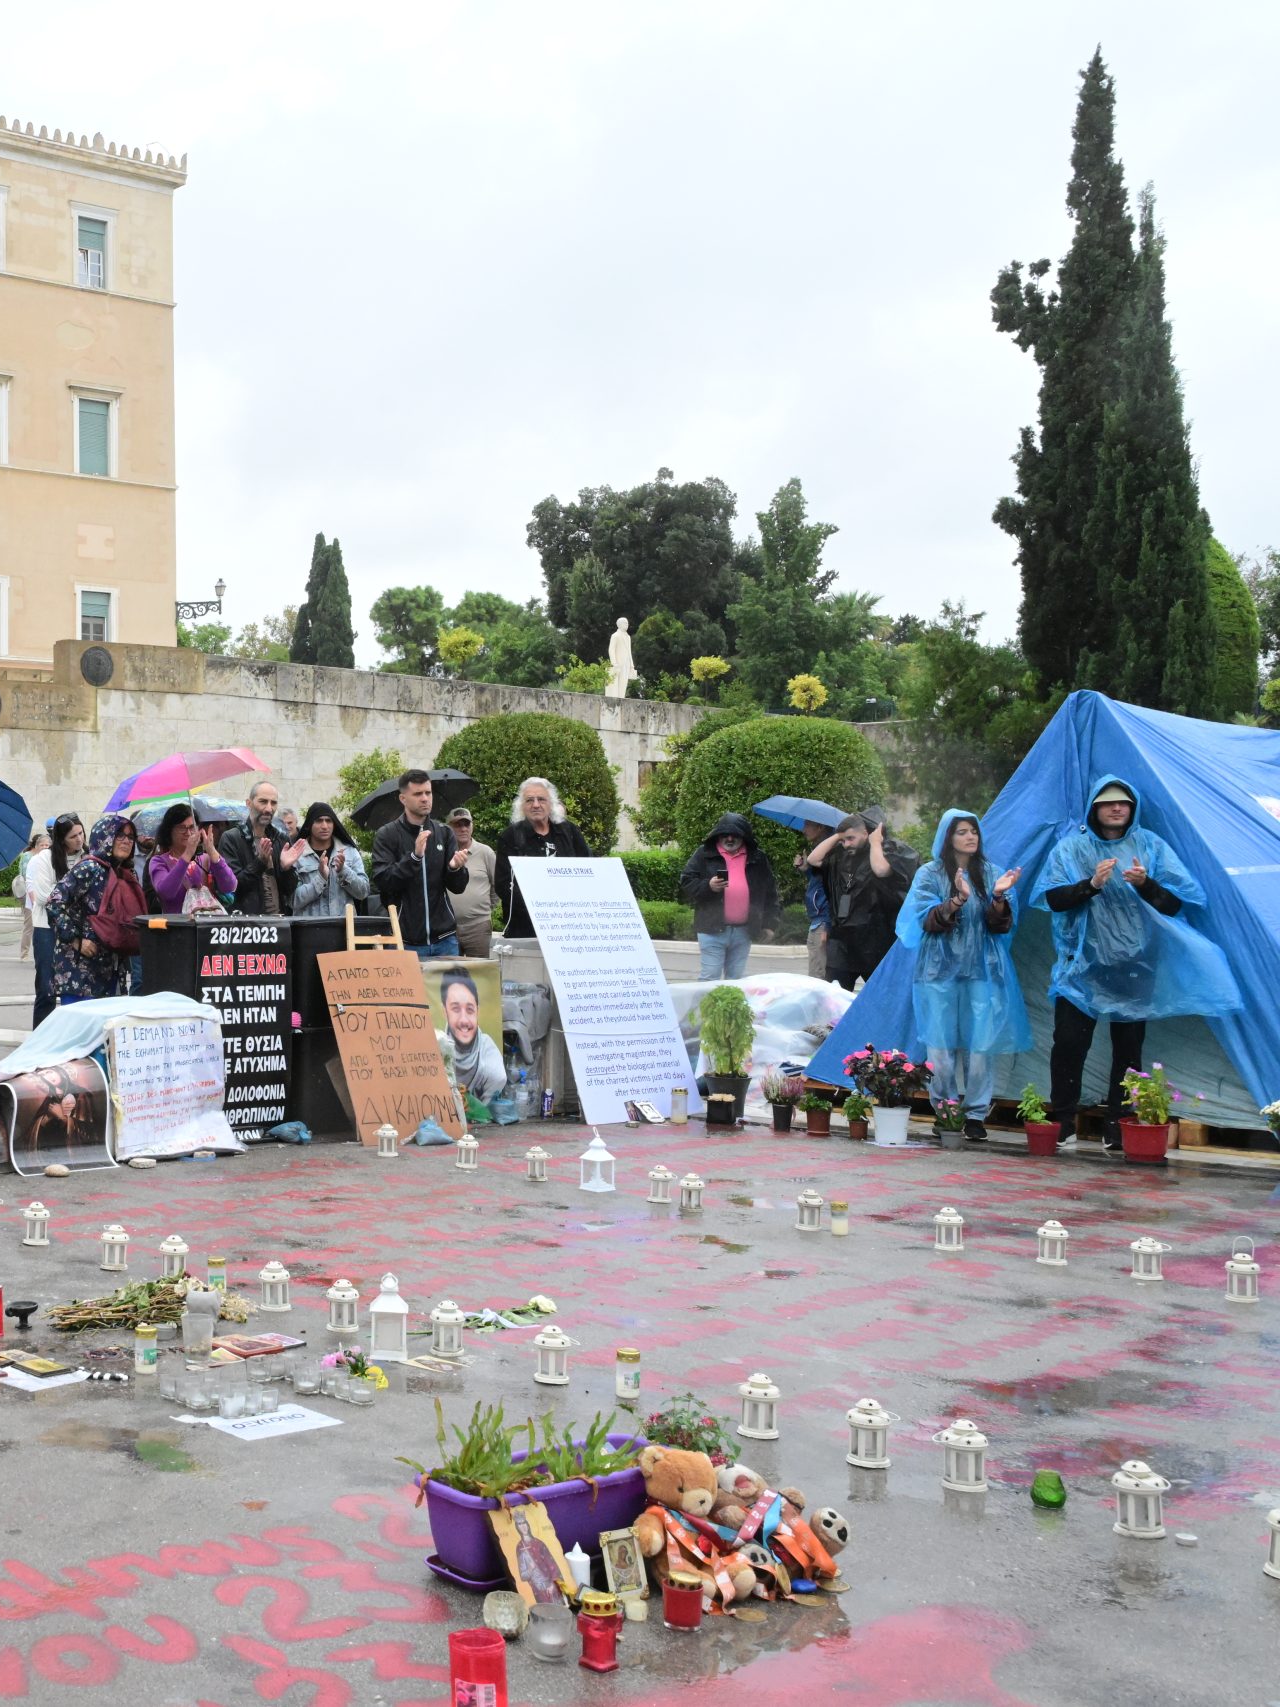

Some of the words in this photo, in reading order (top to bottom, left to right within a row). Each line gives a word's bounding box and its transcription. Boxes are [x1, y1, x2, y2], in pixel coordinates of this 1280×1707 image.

[546, 867, 573, 875] HUNGER
[560, 901, 591, 909] permission
[594, 911, 611, 919] Tempi
[591, 923, 599, 931] by
[210, 926, 278, 944] 28/2/2023
[564, 934, 571, 942] of
[609, 933, 642, 941] determined
[561, 946, 584, 954] through
[585, 945, 620, 953] toxicological
[200, 955, 234, 976] ΔΕΝ
[237, 953, 287, 975] ΞΕΧΝΩ
[554, 969, 566, 977] The
[567, 968, 599, 976] authorities
[615, 967, 635, 975] already
[635, 966, 658, 974] refused
[373, 966, 402, 978] ΤΩΡΑ
[564, 981, 571, 989] to
[572, 982, 588, 990] grant
[588, 980, 620, 989] permission
[201, 986, 234, 1003] ΣΤΑ
[236, 984, 286, 1002] ΤΕΜΠΗ
[329, 990, 352, 1001] ΤΗΝ
[357, 987, 380, 999] ΑΔΕΙΑ
[382, 987, 416, 998] ΕΚΤΑΦΗΣ
[567, 993, 582, 1001] tests
[610, 991, 630, 999] carried
[641, 990, 649, 998] by
[650, 989, 660, 997] the
[570, 1004, 602, 1012] authorities
[603, 1002, 638, 1011] immediately
[640, 1001, 653, 1009] after
[244, 1007, 277, 1024] ΗΤΑΝ
[333, 1011, 368, 1033] ΤΟΥ
[375, 1011, 426, 1030] ΠΑΙΔΙΟΥ
[569, 1016, 596, 1025] accident,
[636, 1013, 651, 1021] have
[120, 1026, 127, 1044] I
[132, 1026, 175, 1041] DEMAND
[178, 1023, 196, 1035] NOW
[245, 1035, 283, 1052] ΘΥΣΙΑ
[369, 1035, 401, 1051] ΜΟΥ
[576, 1041, 600, 1050] Instead,
[601, 1040, 614, 1048] with
[615, 1039, 626, 1047] the
[626, 1038, 659, 1047] permission
[117, 1049, 130, 1059] THE
[135, 1045, 175, 1058] EXHUMATION
[178, 1044, 200, 1053] PERMIT
[587, 1052, 625, 1062] investigating
[625, 1049, 658, 1059] magistrate,
[659, 1048, 672, 1057] they
[234, 1055, 287, 1073] ΑΤΥΧΗΜΑ
[350, 1055, 369, 1067] ΑΠΟ
[376, 1053, 394, 1065] ΤΟΝ
[118, 1068, 127, 1076] MY
[129, 1066, 142, 1076] SON
[349, 1068, 373, 1081] ΠΟΥ
[382, 1066, 408, 1079] ΒΑΣΗ
[585, 1065, 616, 1075] destroyed
[616, 1064, 626, 1072] the
[627, 1062, 655, 1072] biological
[656, 1060, 681, 1069] material
[586, 1079, 593, 1087] of
[594, 1078, 604, 1086] the
[606, 1076, 629, 1085] charred
[629, 1074, 651, 1083] victims
[652, 1074, 663, 1083] just
[663, 1072, 671, 1080] 40
[672, 1071, 686, 1081] days
[227, 1083, 286, 1103] ΔΟΛΟΦΟΝΙΑ
[615, 1088, 629, 1097] after
[629, 1087, 640, 1095] the
[641, 1086, 659, 1094] crime
[659, 1085, 666, 1093] in
